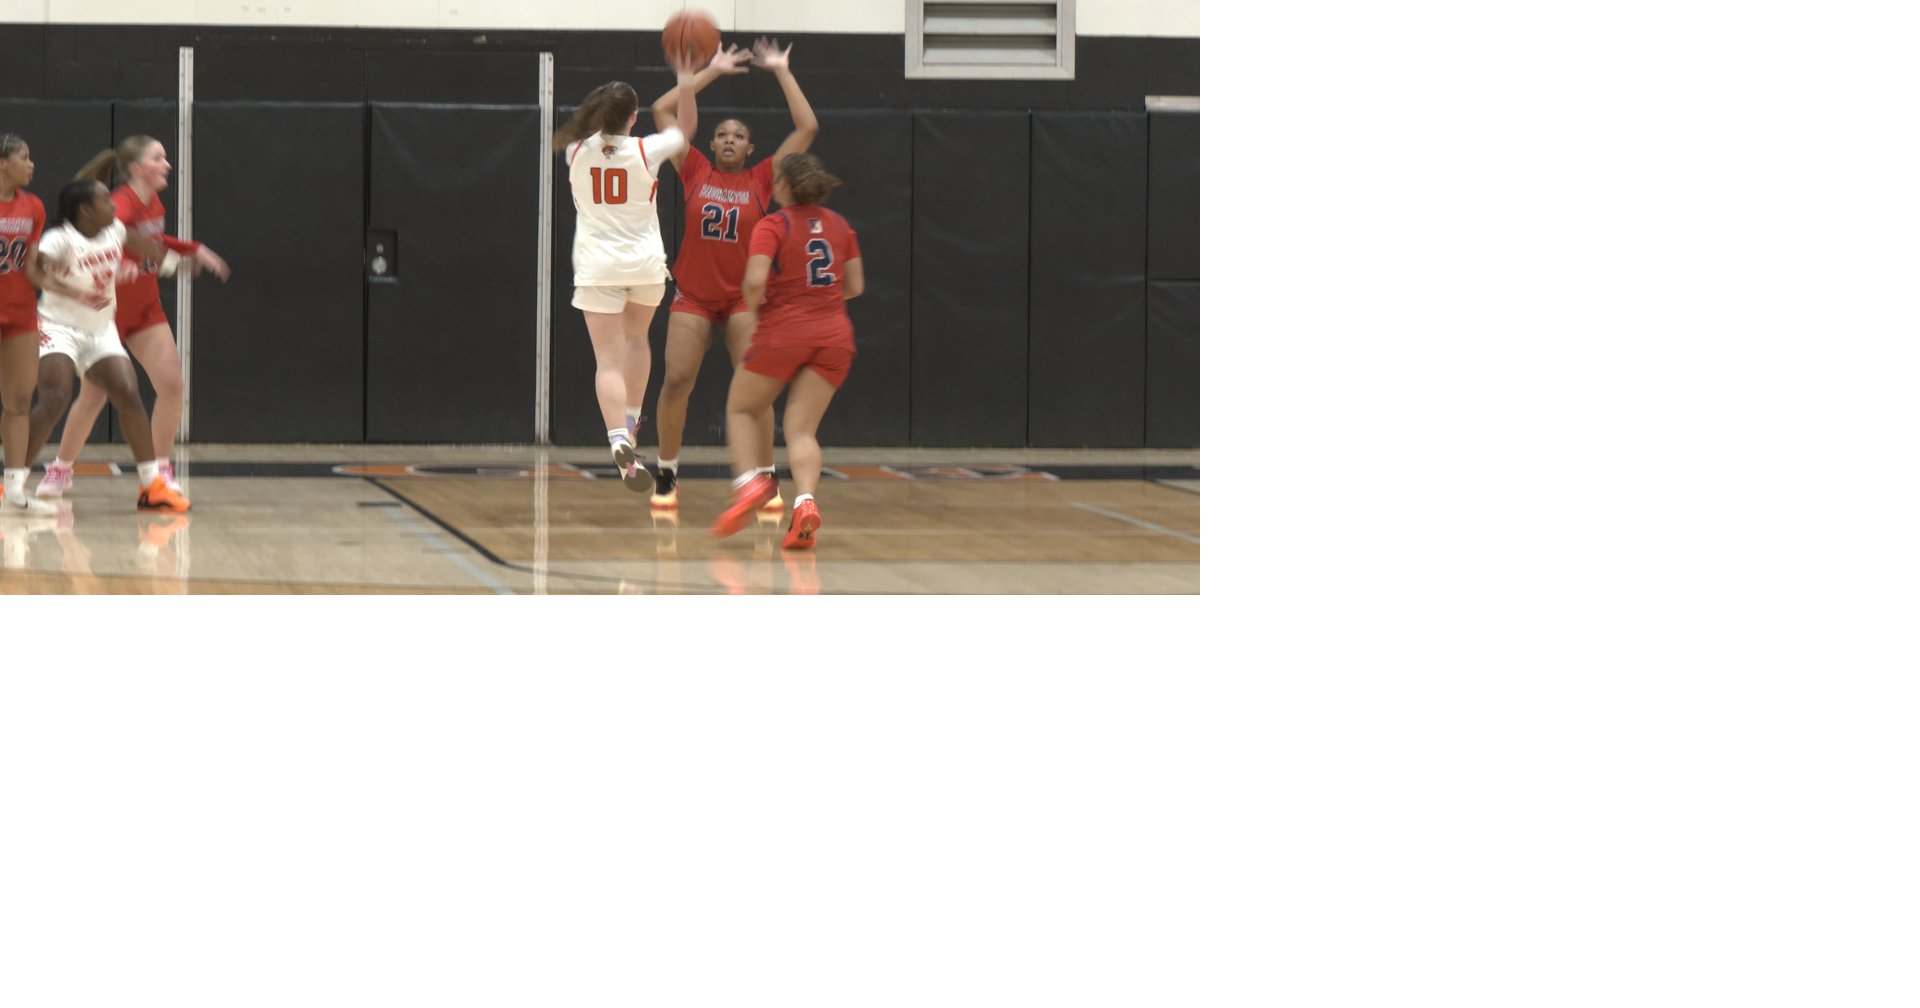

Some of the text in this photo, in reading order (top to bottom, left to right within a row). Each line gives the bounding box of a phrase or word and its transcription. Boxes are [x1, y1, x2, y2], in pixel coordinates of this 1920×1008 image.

[590, 167, 628, 204] 10
[701, 202, 740, 243] 21
[806, 238, 836, 287] 2
